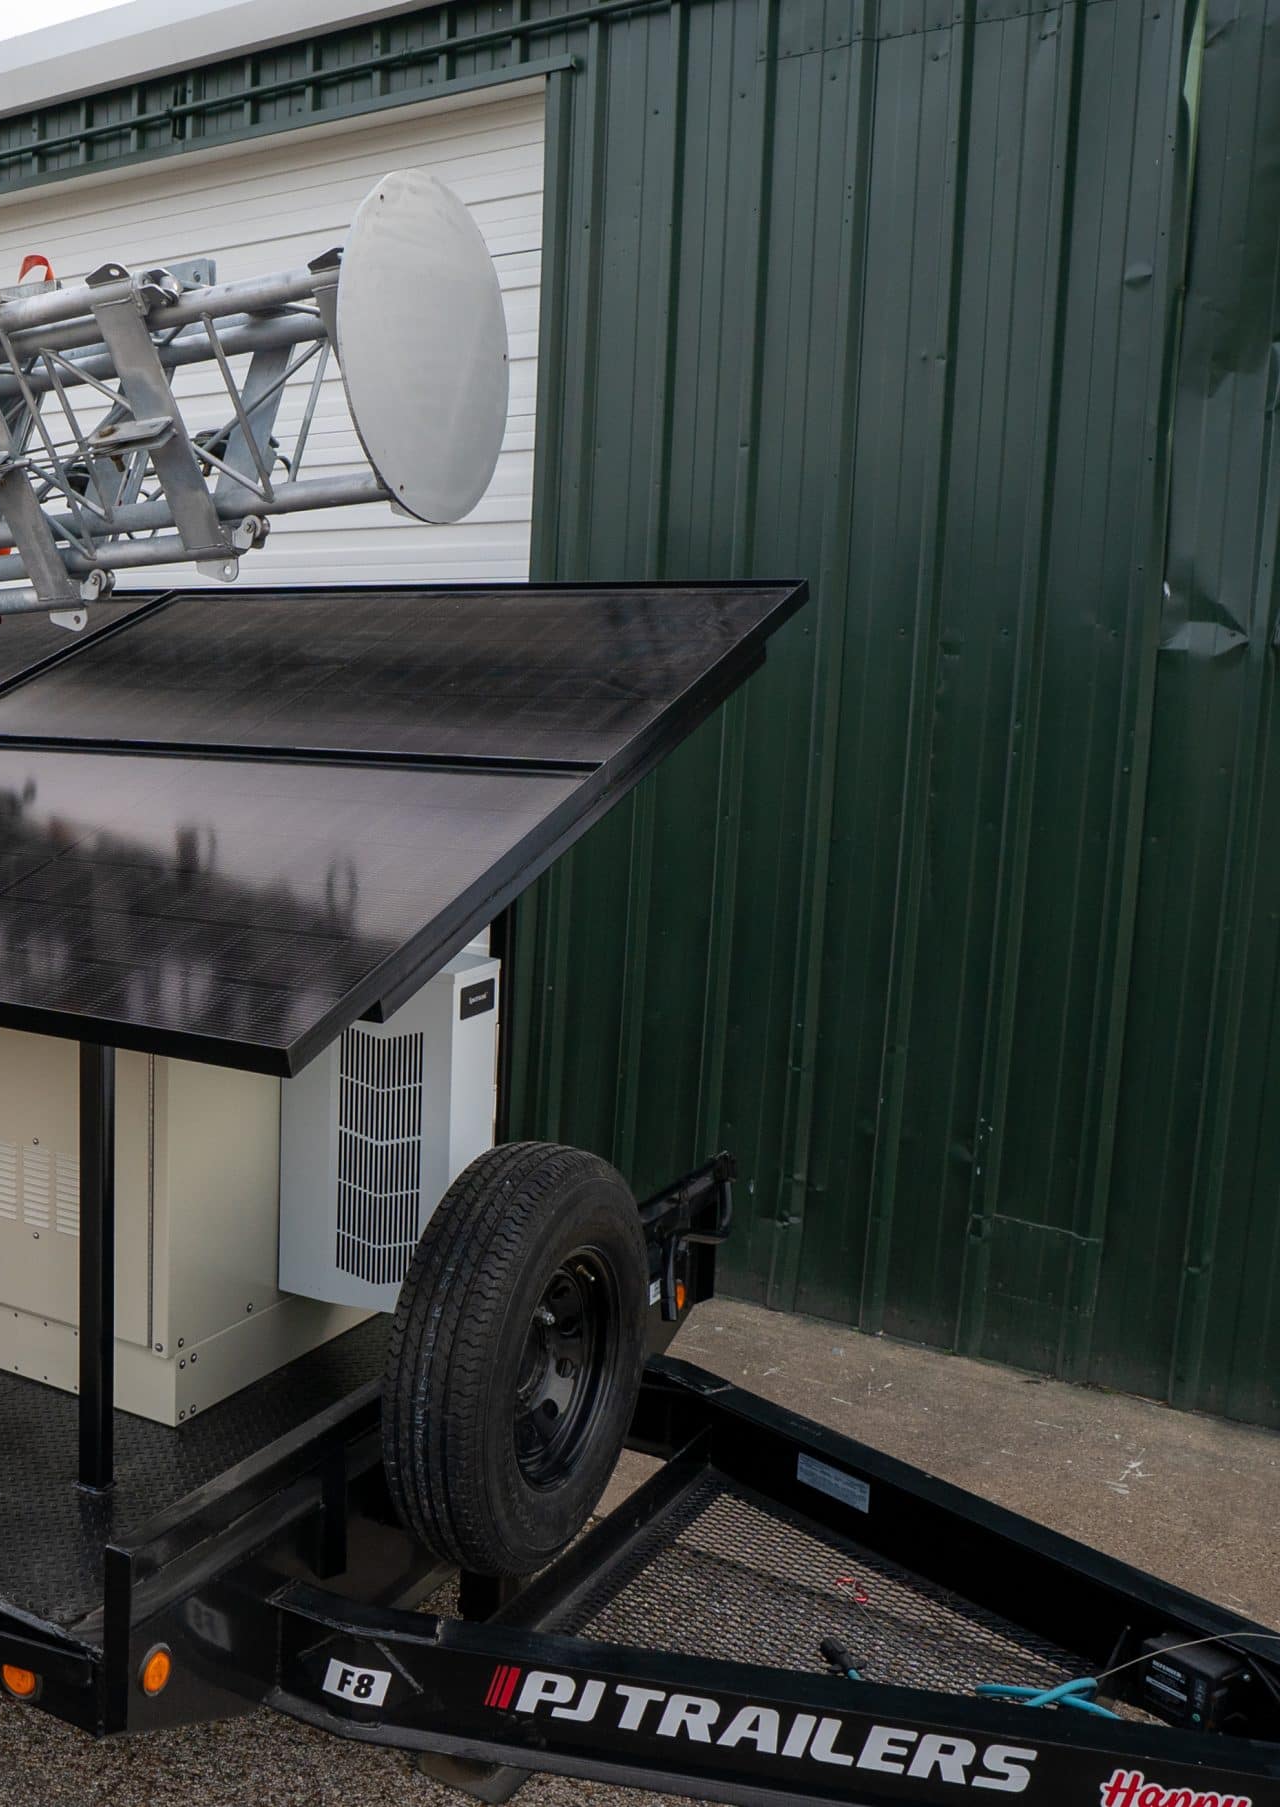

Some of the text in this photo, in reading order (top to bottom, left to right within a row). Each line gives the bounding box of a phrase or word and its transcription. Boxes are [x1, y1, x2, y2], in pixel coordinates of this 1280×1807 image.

[336, 1668, 376, 1699] F8
[515, 1670, 1038, 1793] PJ TRAILERS
[1100, 1769, 1253, 1807] Happ
